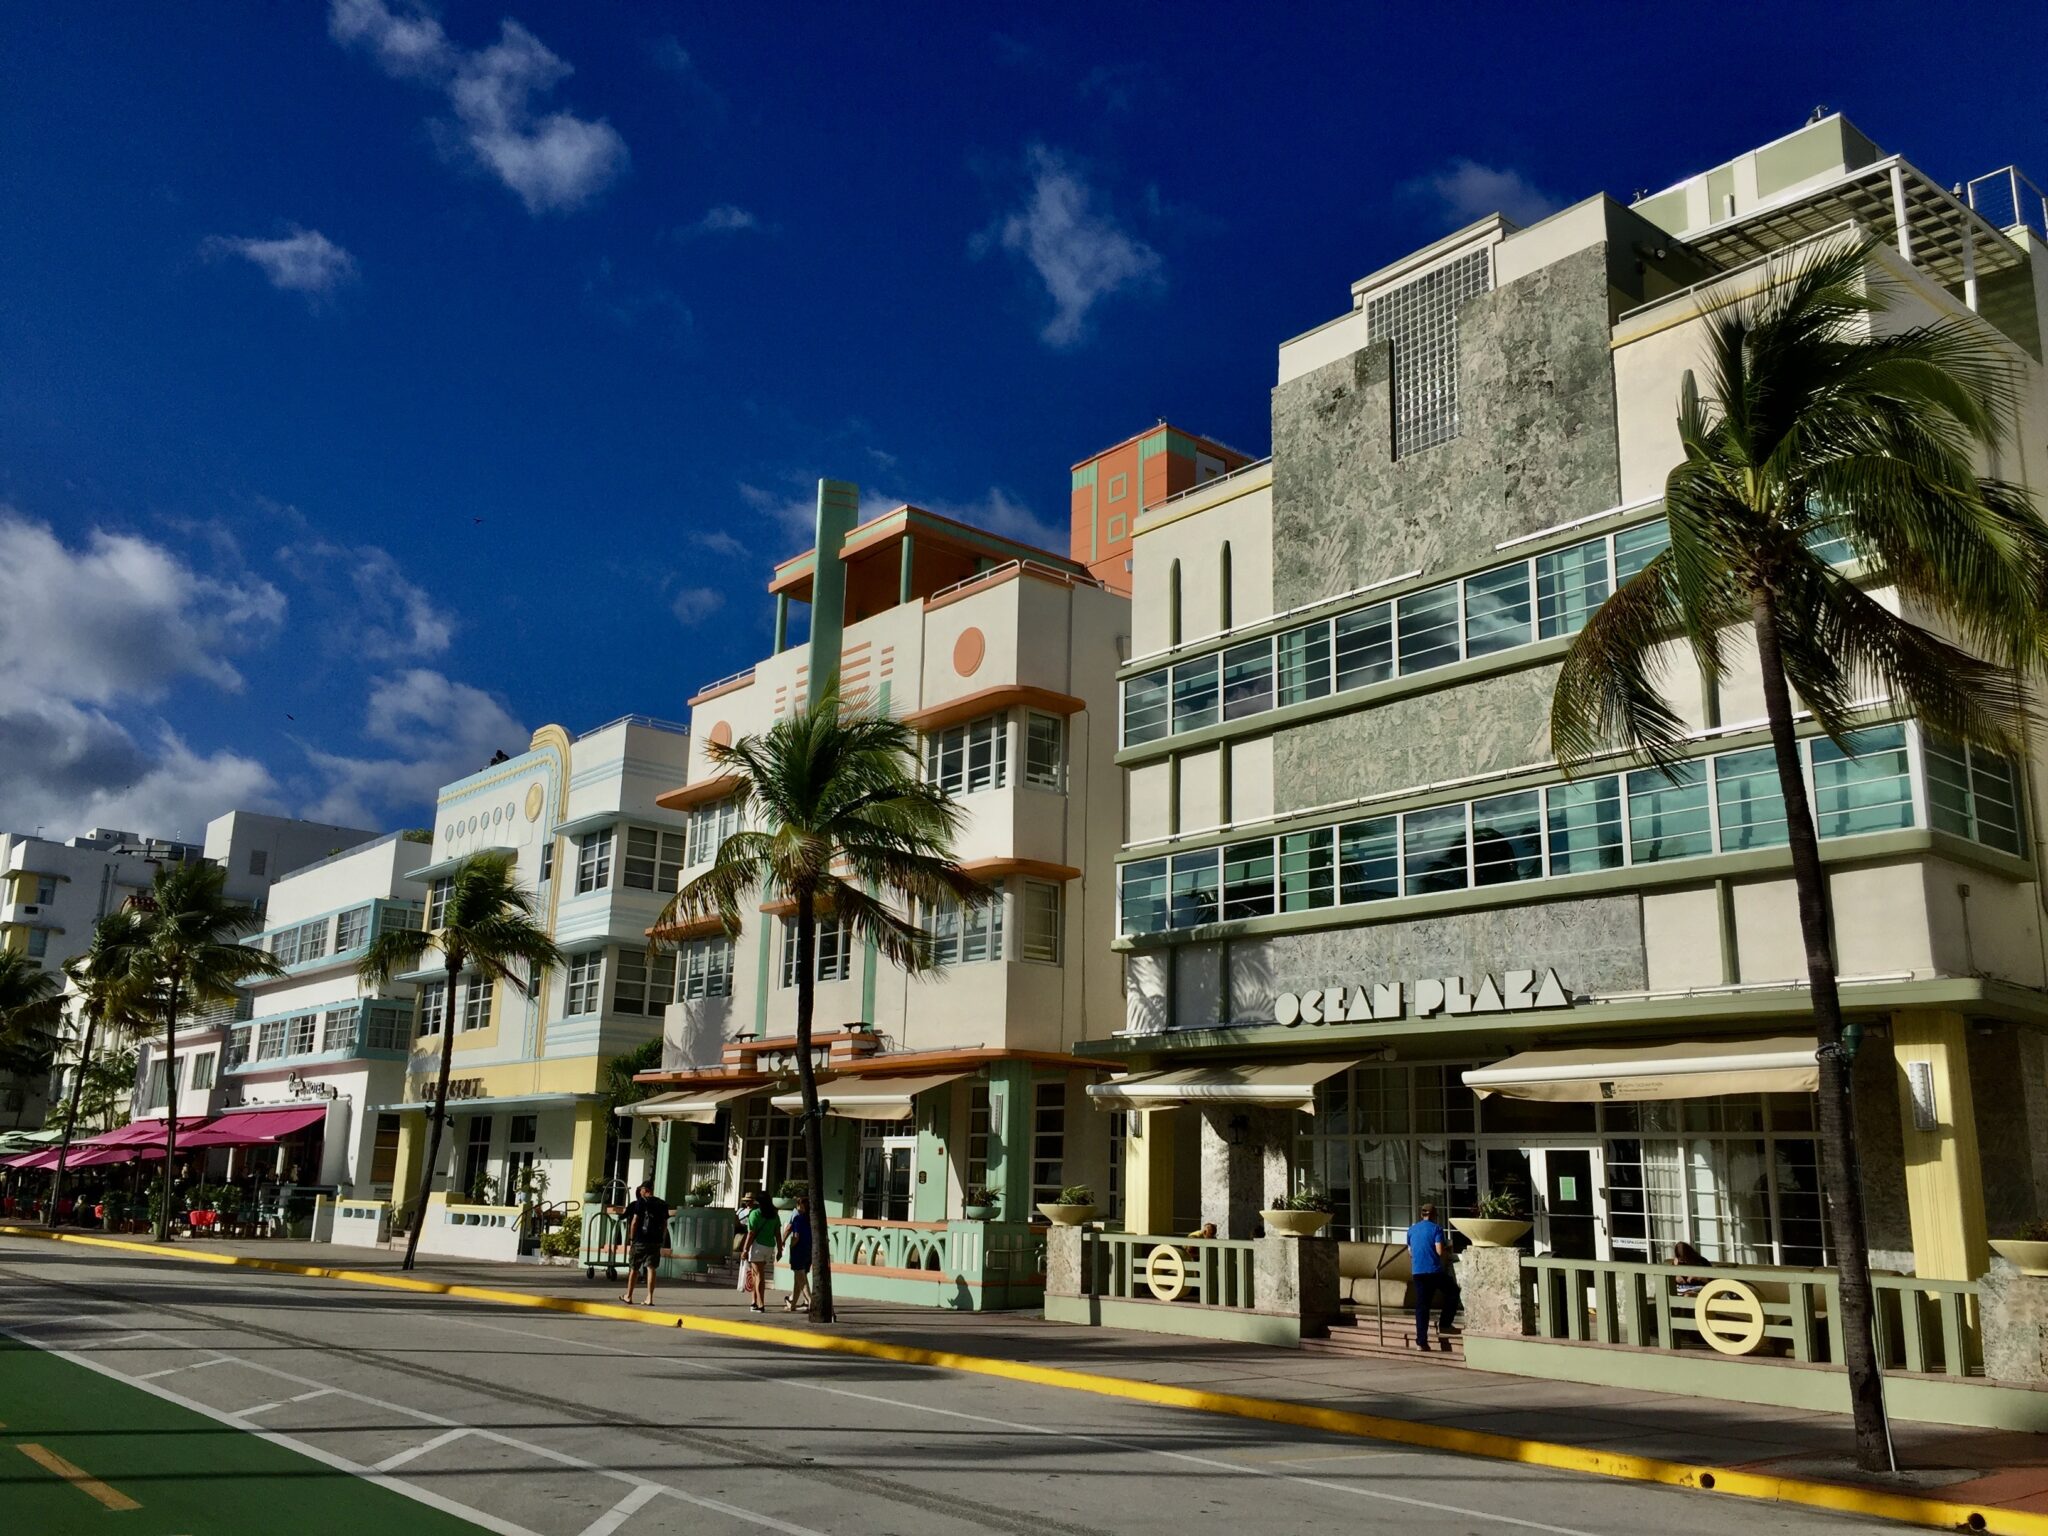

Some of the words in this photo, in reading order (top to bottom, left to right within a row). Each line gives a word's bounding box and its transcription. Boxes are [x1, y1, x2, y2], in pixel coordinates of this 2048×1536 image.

[1274, 981, 1402, 1027] OCEAN
[1414, 967, 1570, 1017] PLAZA
[420, 1077, 484, 1101] CRCENT
